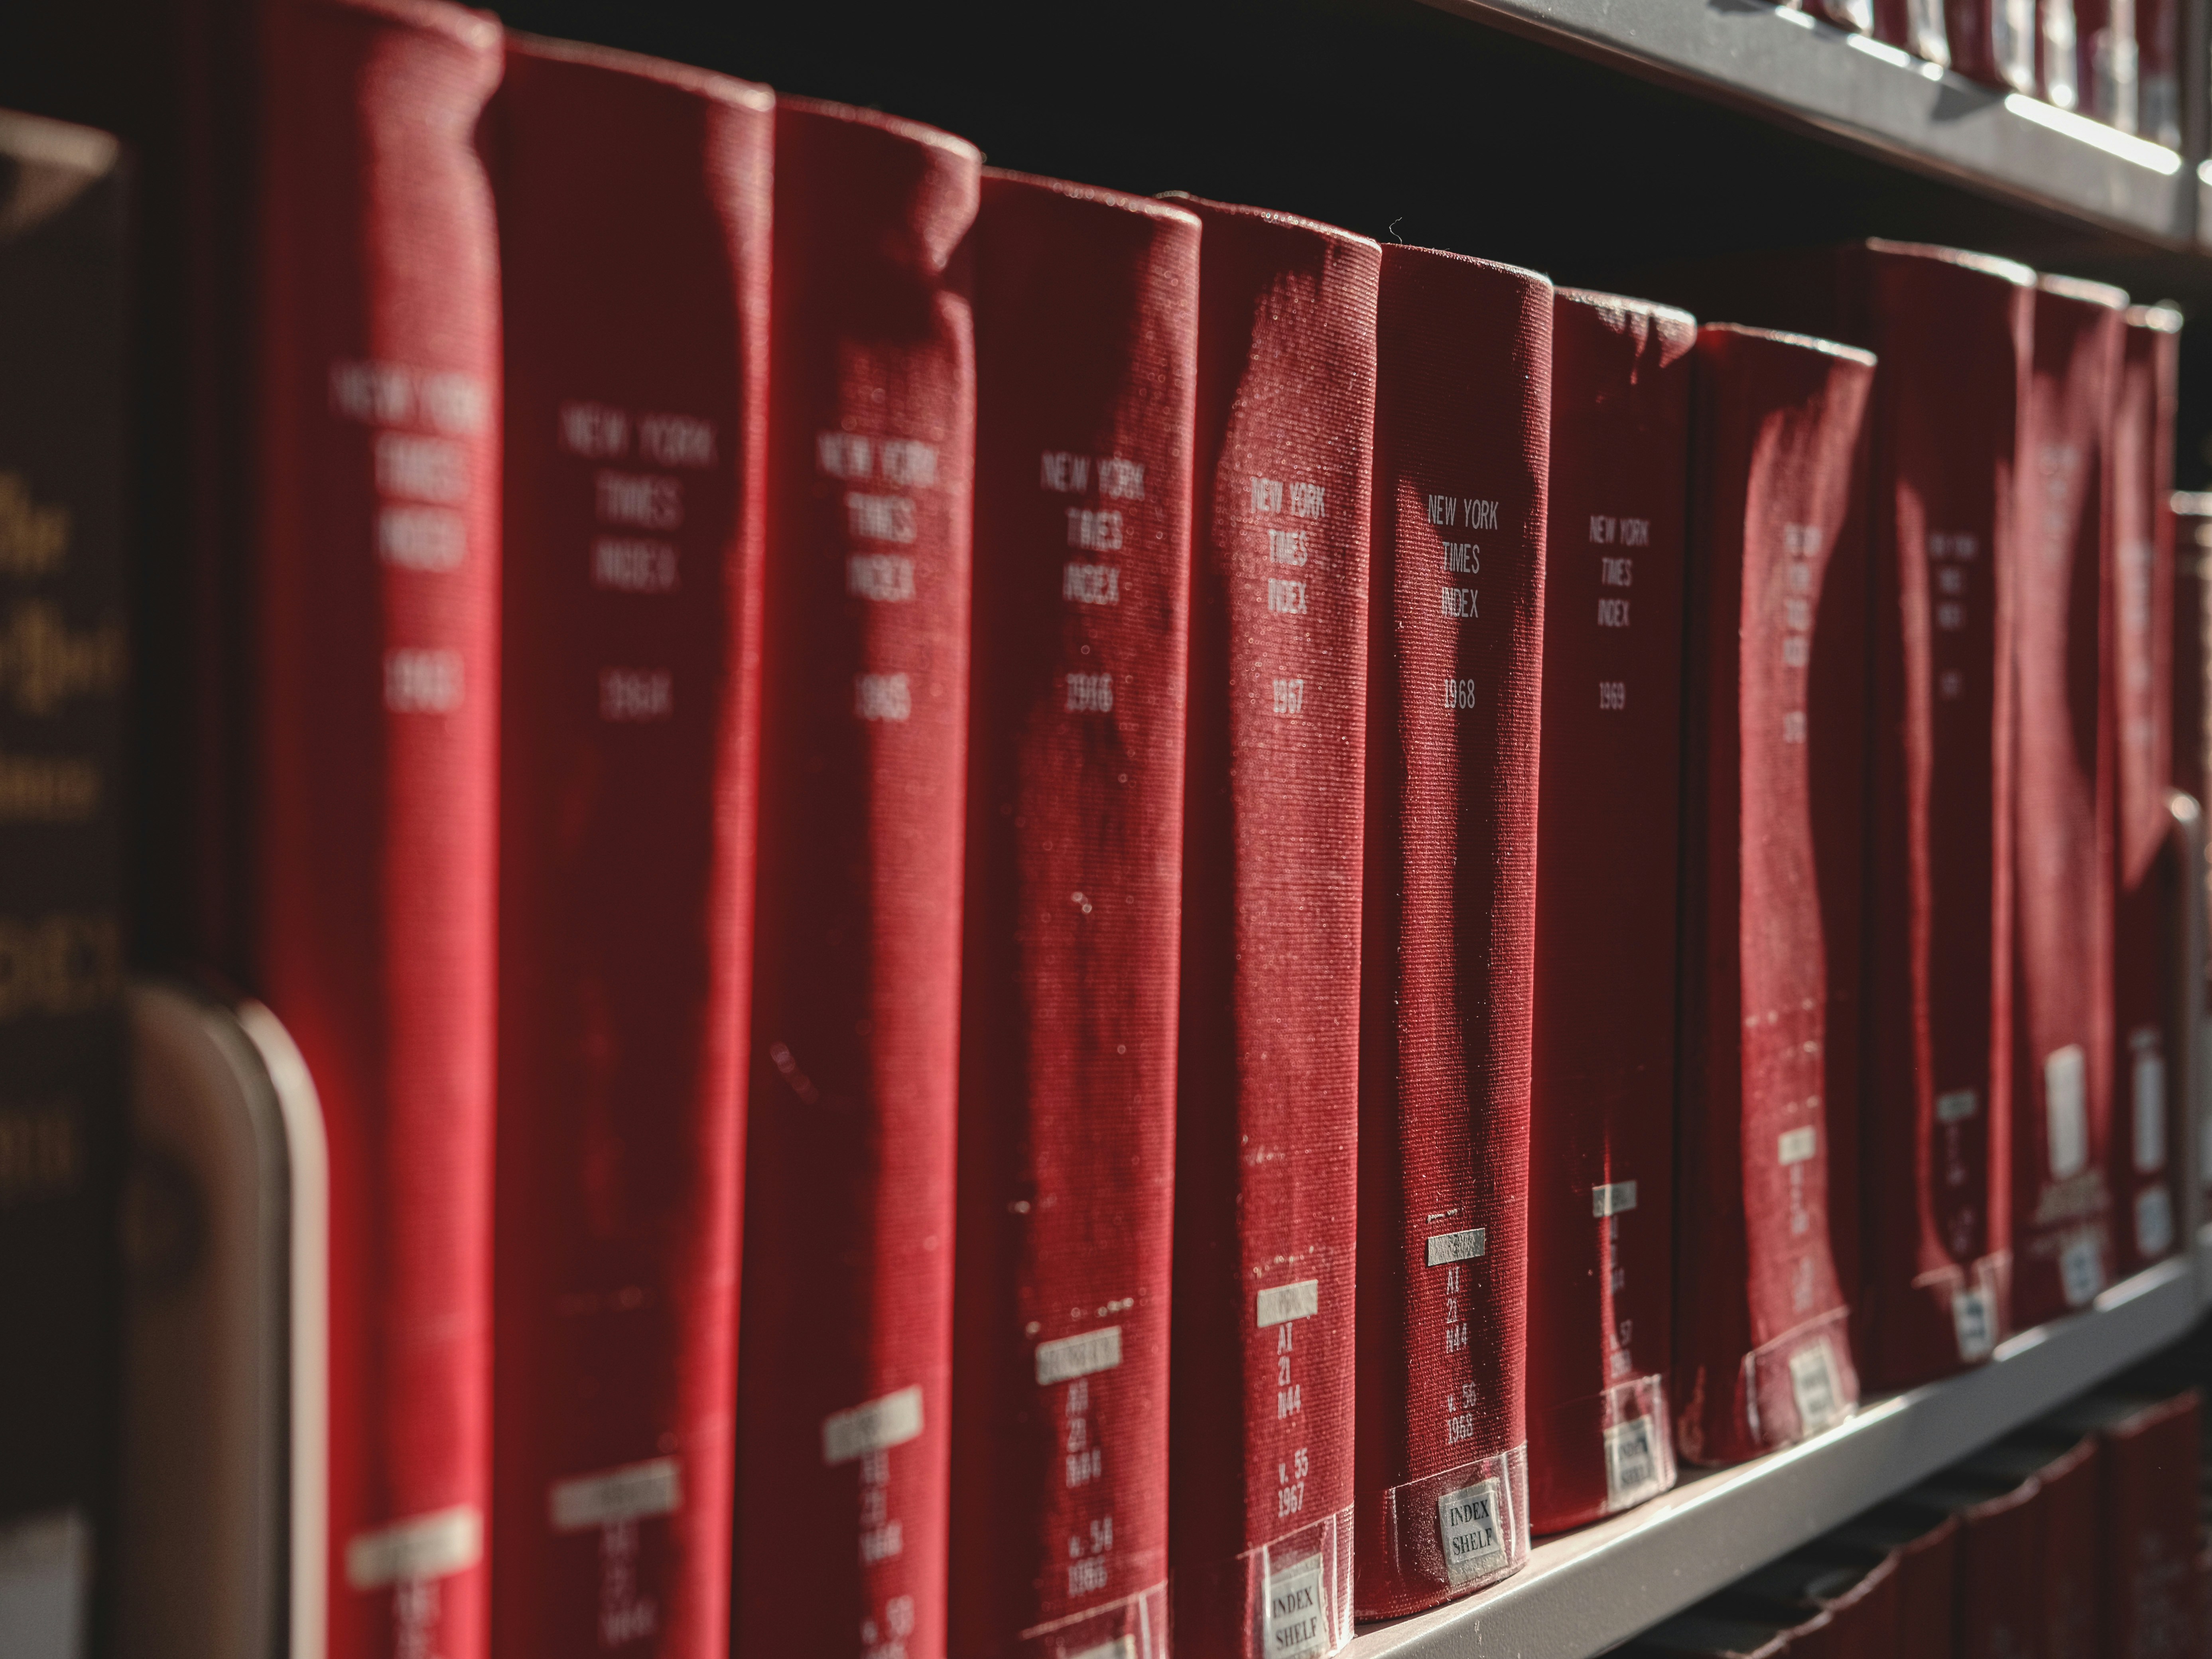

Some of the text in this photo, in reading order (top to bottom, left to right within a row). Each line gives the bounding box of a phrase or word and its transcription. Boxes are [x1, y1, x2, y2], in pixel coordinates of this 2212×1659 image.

[1040, 451, 1144, 501] NEW YORK
[1251, 478, 1325, 517] NEW YORK
[1428, 495, 1499, 530] NEW YORK
[1066, 507, 1123, 551] TIMES
[1590, 515, 1649, 546] NEW YORK
[1269, 529, 1307, 566] TIMES
[1442, 542, 1480, 573] TIMES
[1063, 562, 1119, 605] INDEX
[1602, 558, 1632, 587] TIMES
[1269, 578, 1307, 614] INDEX
[1441, 587, 1478, 618] INDEX
[1598, 599, 1630, 627] INDEX
[1273, 679, 1304, 714] 1967
[1444, 679, 1475, 709] 1968
[1599, 681, 1625, 710] 1969
[1447, 1298, 1458, 1323] 21
[1278, 1322, 1292, 1355] AI
[1446, 1323, 1467, 1353] N44
[1278, 1357, 1290, 1386] 21
[1278, 1384, 1300, 1420] N44
[1463, 1382, 1477, 1408] 56
[1448, 1412, 1473, 1444] 1968
[1294, 1448, 1308, 1478] 55
[1278, 1481, 1304, 1518] 1967
[1450, 1499, 1490, 1527] INDEX
[1452, 1528, 1492, 1555] SHELF
[1272, 1585, 1314, 1618] INDEX
[1276, 1616, 1318, 1651] SHELF
